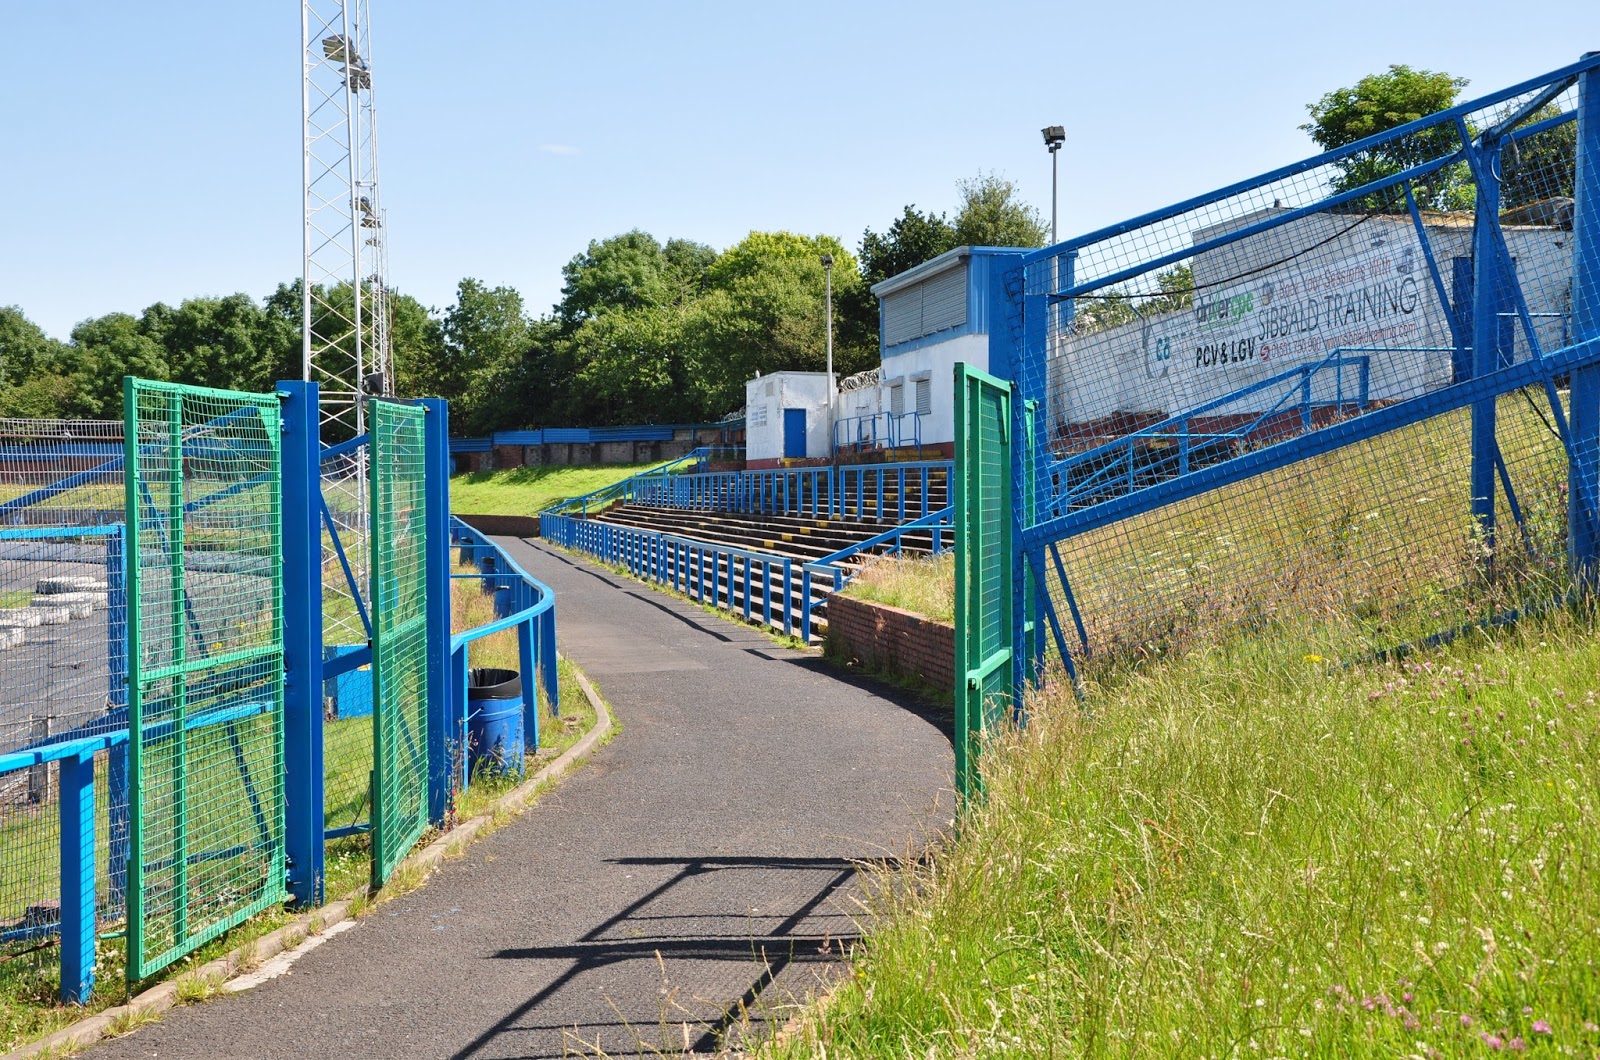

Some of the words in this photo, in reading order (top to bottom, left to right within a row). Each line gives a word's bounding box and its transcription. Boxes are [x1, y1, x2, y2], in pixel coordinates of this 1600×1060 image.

[1258, 298, 1318, 341] SIBBALD
[1324, 277, 1417, 328] TRAINING
[1196, 344, 1218, 368] PCV
[1220, 342, 1228, 365] &
[1231, 337, 1256, 362] LGV
